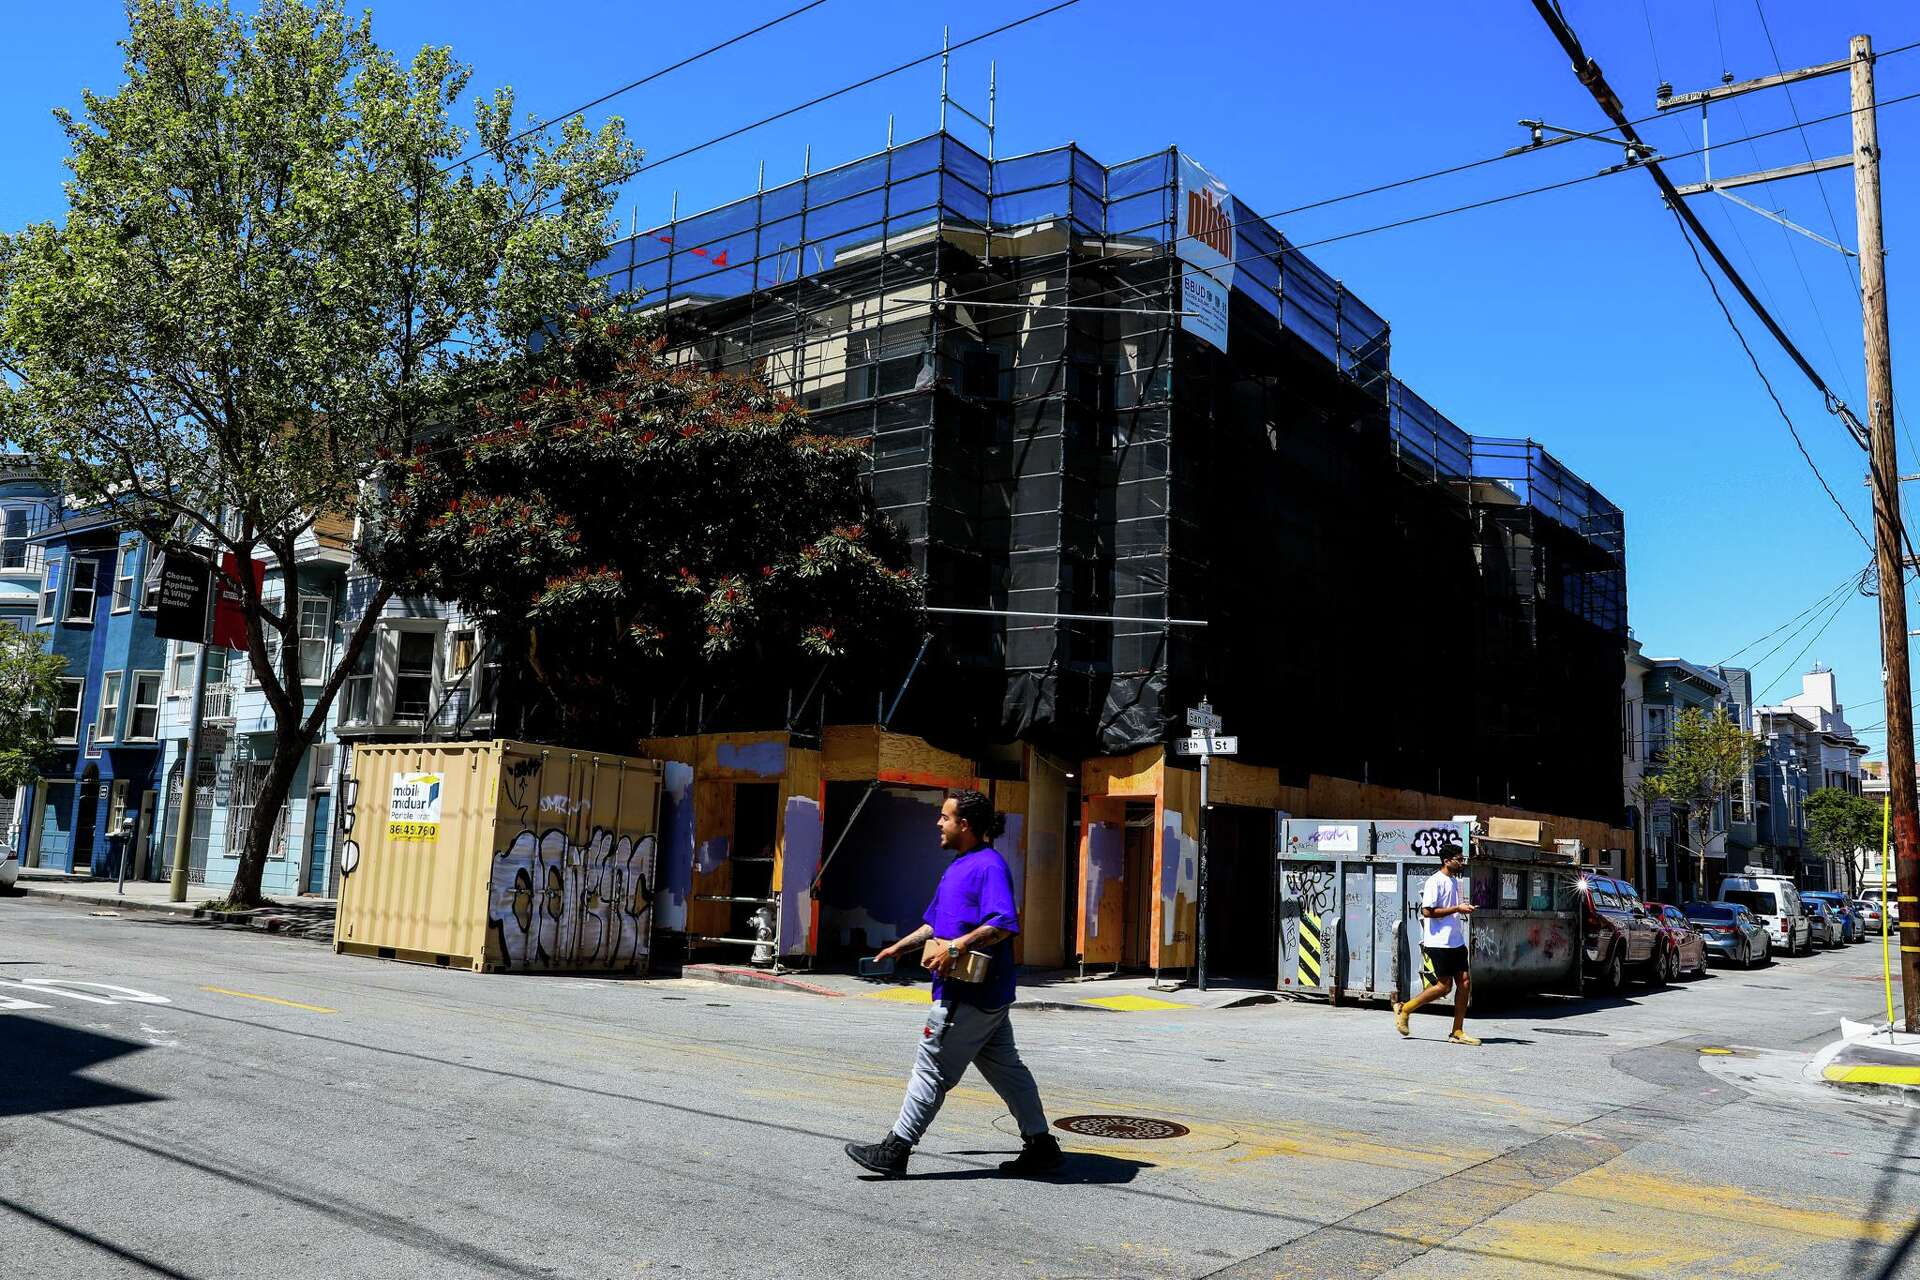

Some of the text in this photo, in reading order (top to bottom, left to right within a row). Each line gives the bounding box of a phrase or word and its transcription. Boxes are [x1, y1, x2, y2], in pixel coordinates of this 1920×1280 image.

[164, 580, 199, 592] Applause
[163, 588, 192, 600] & Witty
[1189, 712, 1201, 724] San
[1179, 741, 1227, 750] 18th St
[392, 797, 426, 809] mduar
